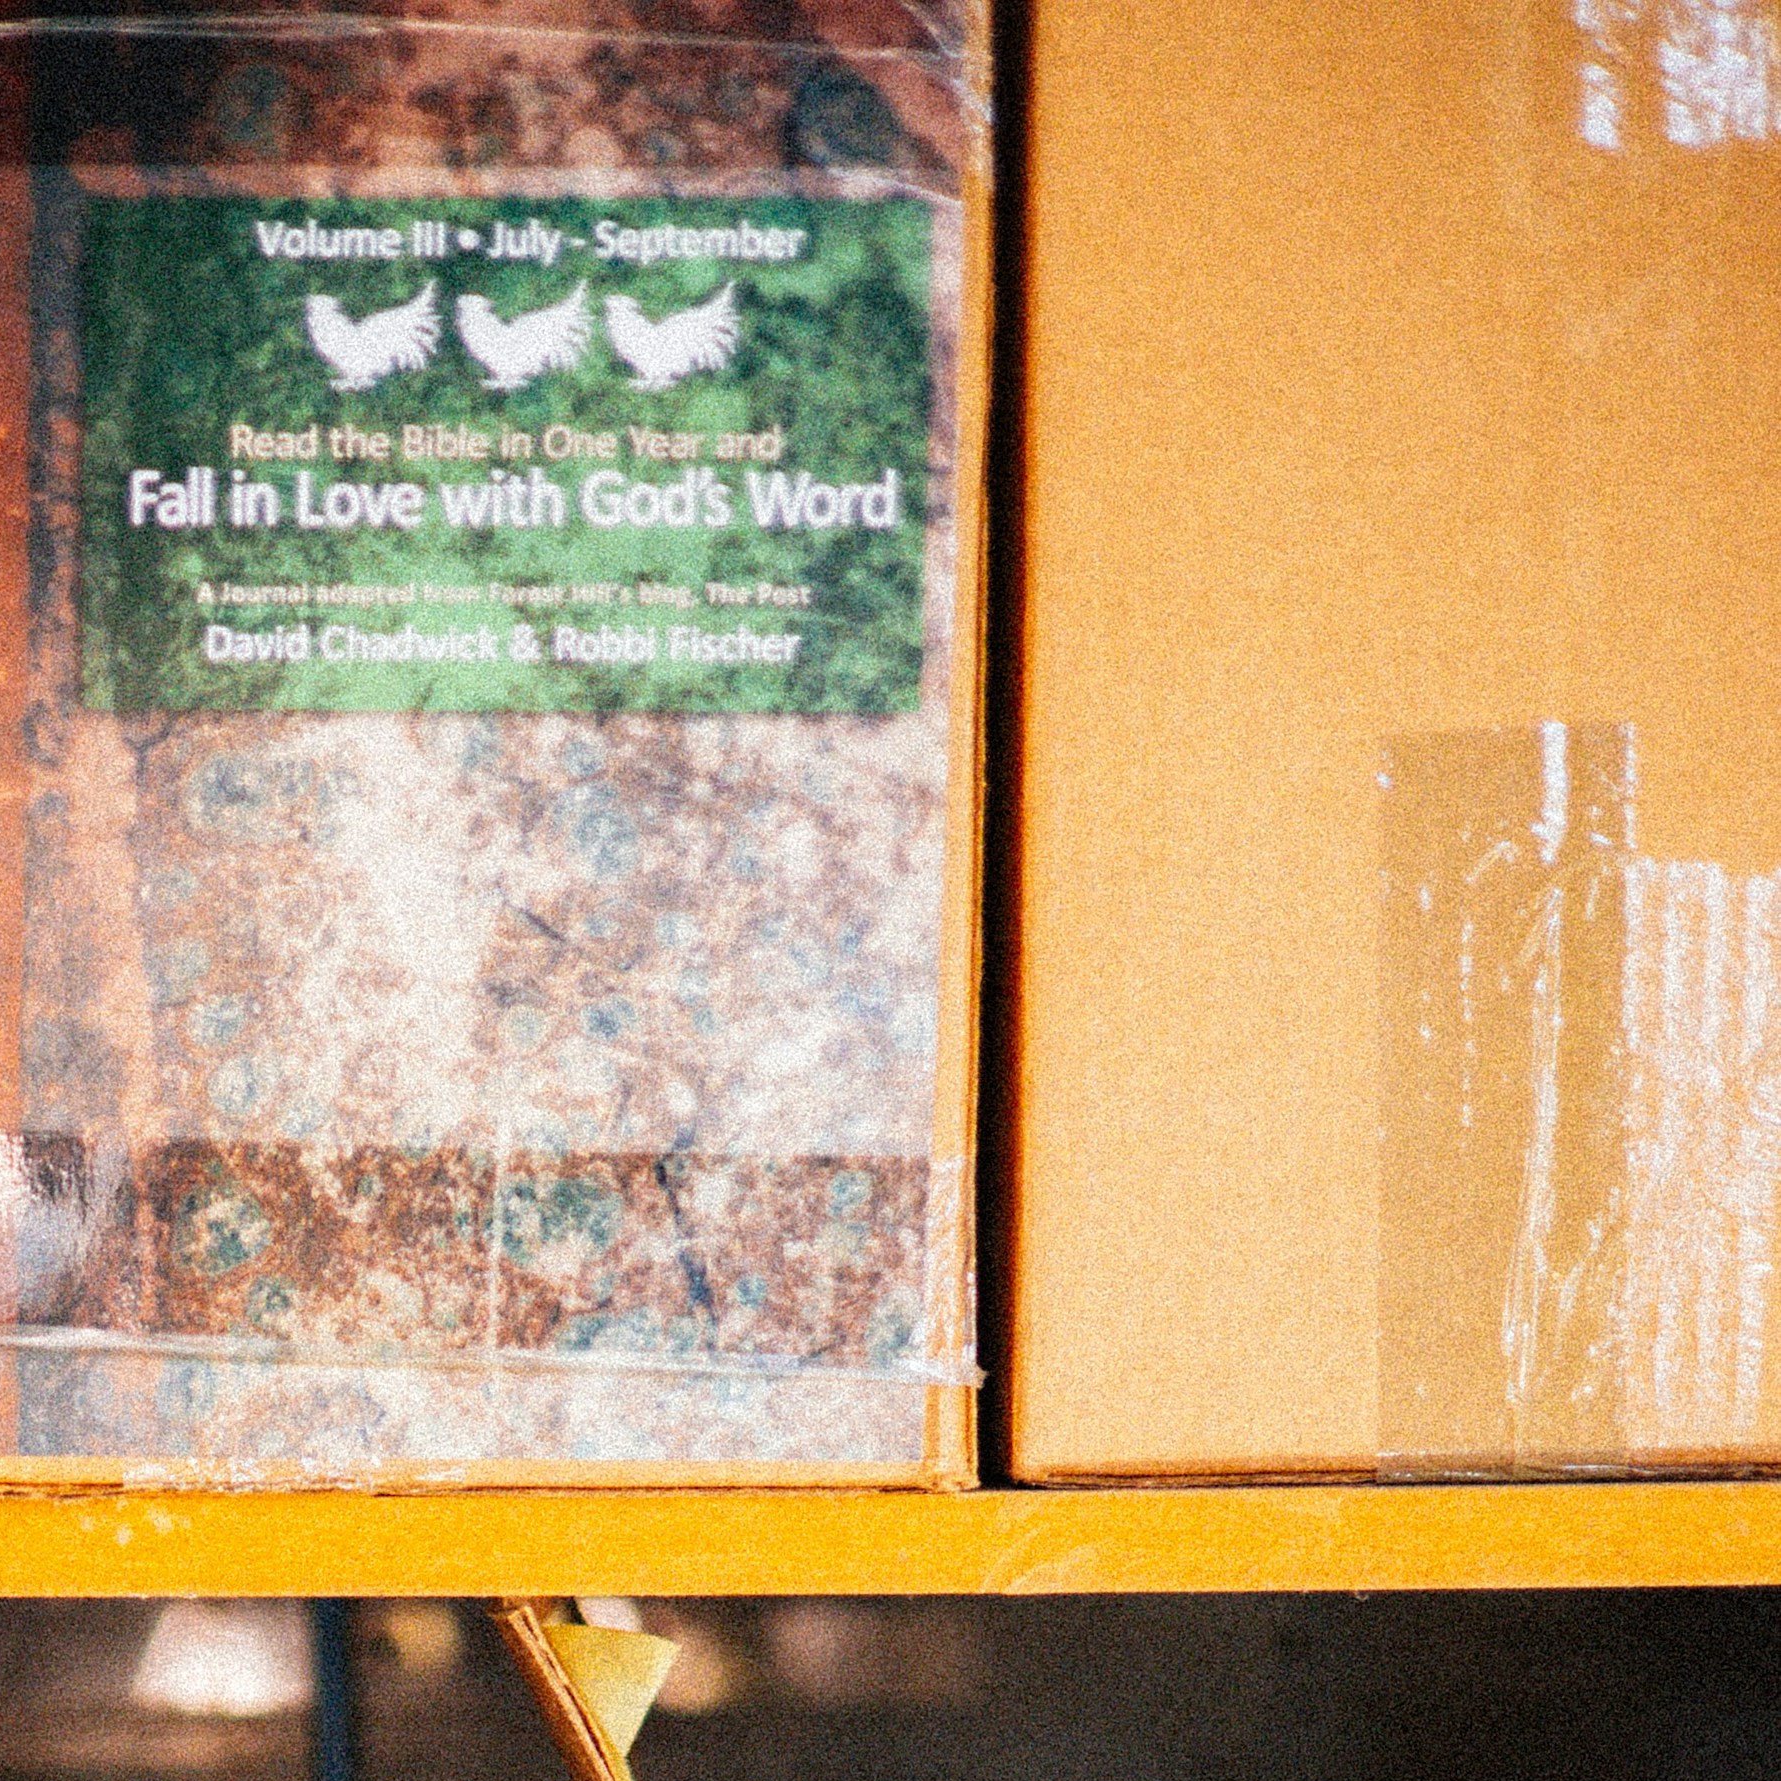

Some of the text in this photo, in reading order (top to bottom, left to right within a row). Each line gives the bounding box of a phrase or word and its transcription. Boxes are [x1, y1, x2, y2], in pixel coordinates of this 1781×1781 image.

[254, 219, 402, 259] Volume
[413, 220, 445, 258] III
[486, 219, 561, 267] July
[594, 220, 807, 266] September
[229, 423, 782, 462] Read the Bible in One Year and
[128, 466, 900, 529] Fall in Love with God's Word
[219, 582, 309, 605] Journal
[705, 581, 752, 606] The
[756, 583, 812, 609] Post
[206, 623, 800, 664] David Chadwick & Robbi Fischer
